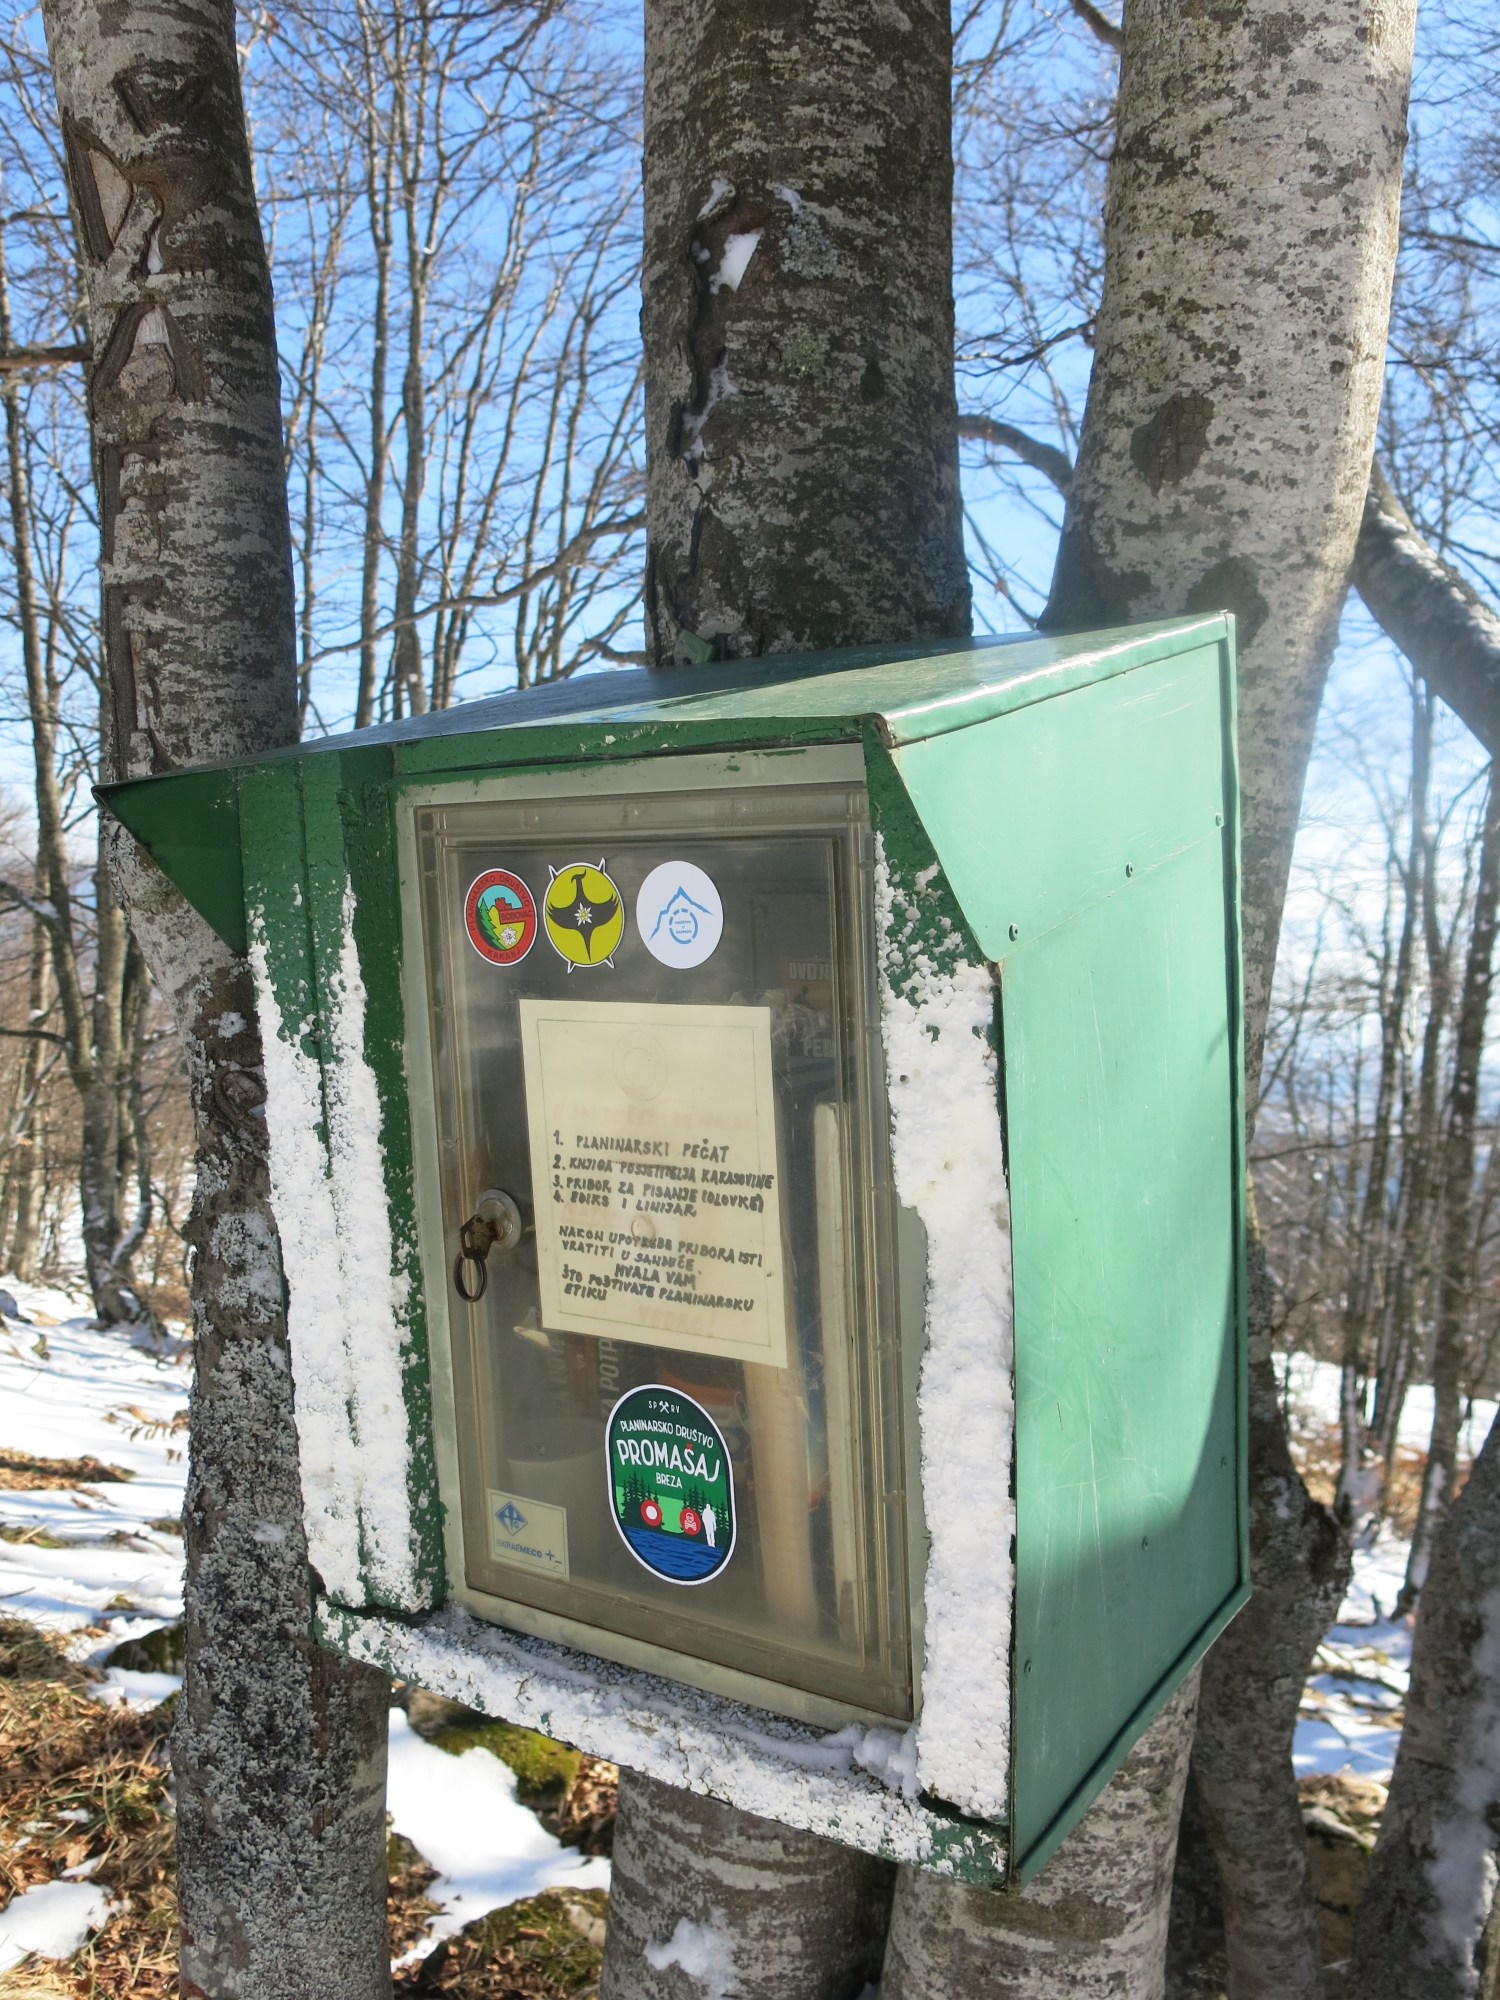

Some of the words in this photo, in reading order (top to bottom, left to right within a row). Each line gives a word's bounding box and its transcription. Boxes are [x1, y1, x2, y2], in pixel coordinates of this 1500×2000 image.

[468, 875, 496, 931] PLANINARSKO
[487, 947, 522, 960] KAKANJ
[553, 1129, 564, 1146] 1.
[576, 1135, 670, 1157] PLANINARSKI
[552, 1153, 566, 1170] 2.
[569, 1157, 613, 1173] KNJIGA
[552, 1174, 564, 1189] 3.
[566, 1177, 612, 1194] PRIBOR
[618, 1181, 634, 1196] ZA
[642, 1183, 698, 1204] PISANJE
[553, 1189, 564, 1203] 4.
[621, 1197, 628, 1209] I
[635, 1199, 697, 1218] LINIJAR
[559, 1225, 604, 1242] NAKON
[678, 1240, 735, 1264] PRIBORA
[738, 1251, 763, 1268] ISTI
[561, 1239, 615, 1258] VRATITI
[621, 1249, 631, 1261] U
[614, 1262, 661, 1284] HVALA
[666, 1271, 697, 1290] VAM
[563, 1282, 608, 1301] ETIKU
[659, 1287, 755, 1312] PLANINARSKU
[620, 1419, 673, 1435] PLANINARSKO
[675, 1425, 714, 1448] DRUŠTVO
[616, 1439, 720, 1483] PROMAŠAJ
[655, 1472, 683, 1489] BREZA
